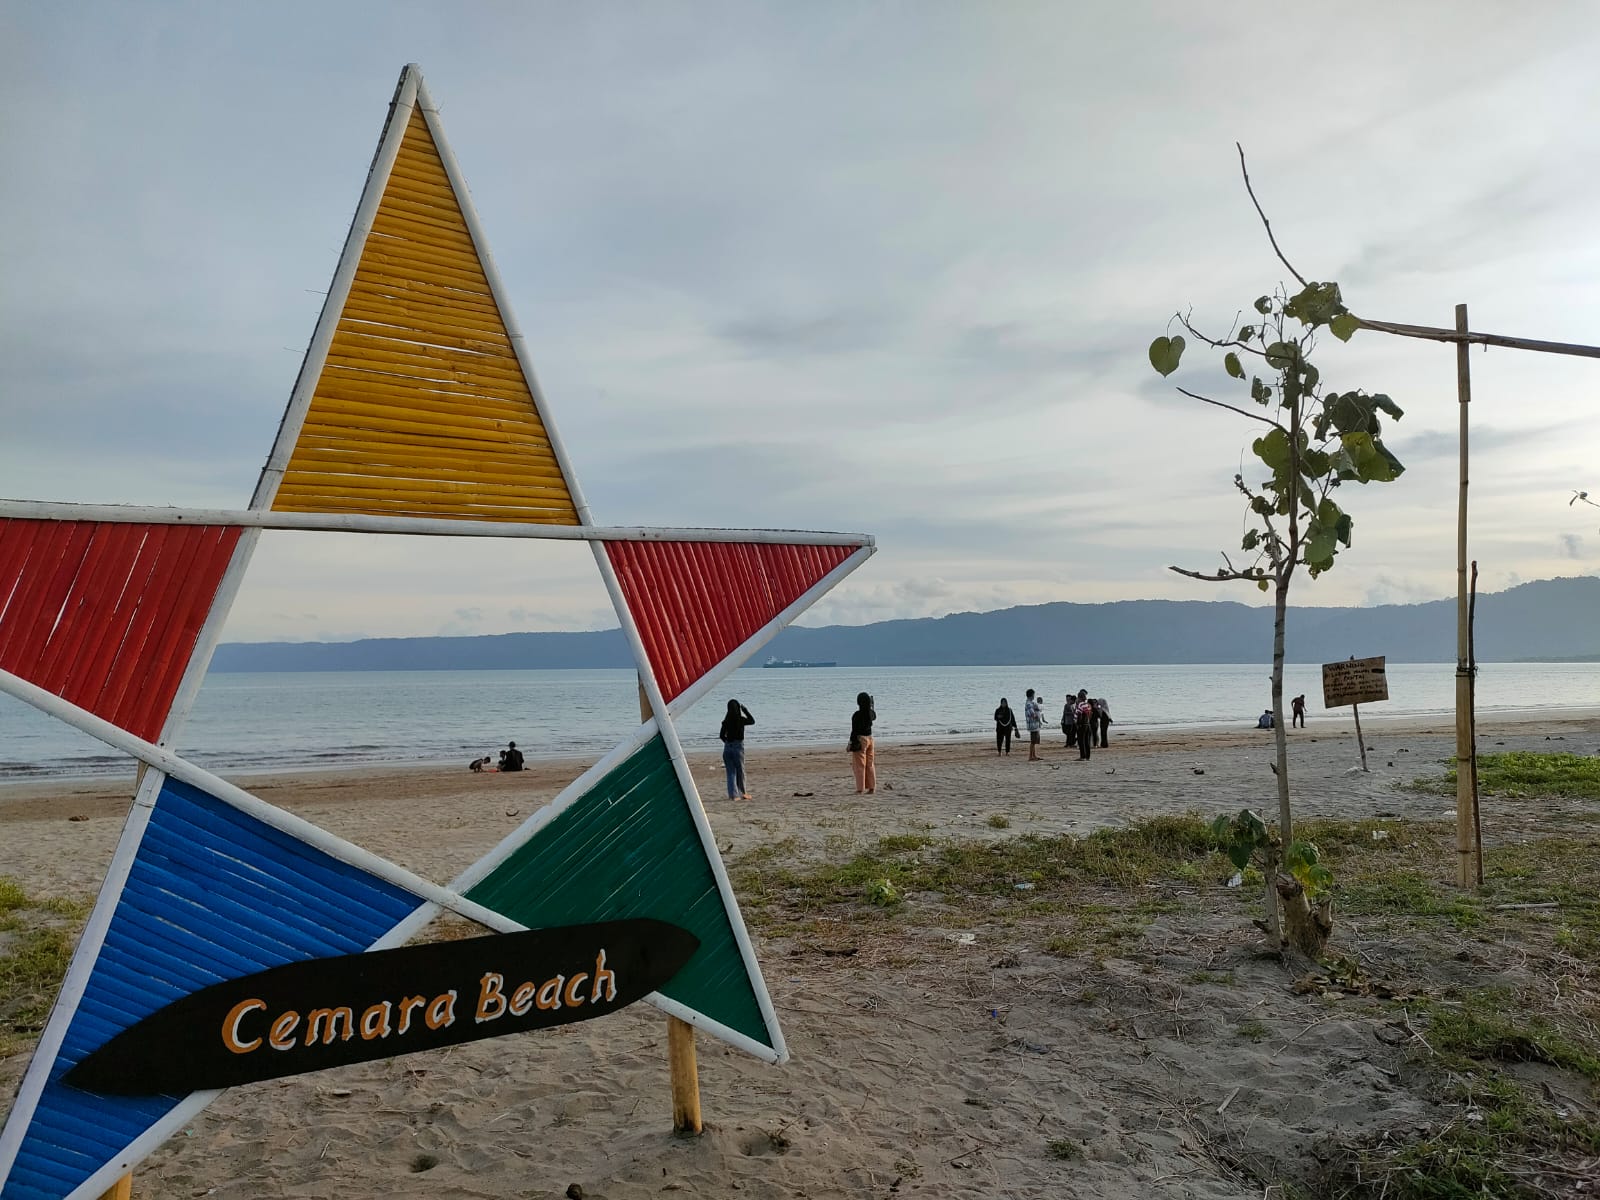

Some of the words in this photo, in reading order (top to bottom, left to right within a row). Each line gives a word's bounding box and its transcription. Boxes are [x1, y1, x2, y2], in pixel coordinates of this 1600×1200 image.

[1328, 662, 1365, 672] WARNING
[221, 988, 457, 1054] Cemara
[475, 948, 617, 1024] Beach
